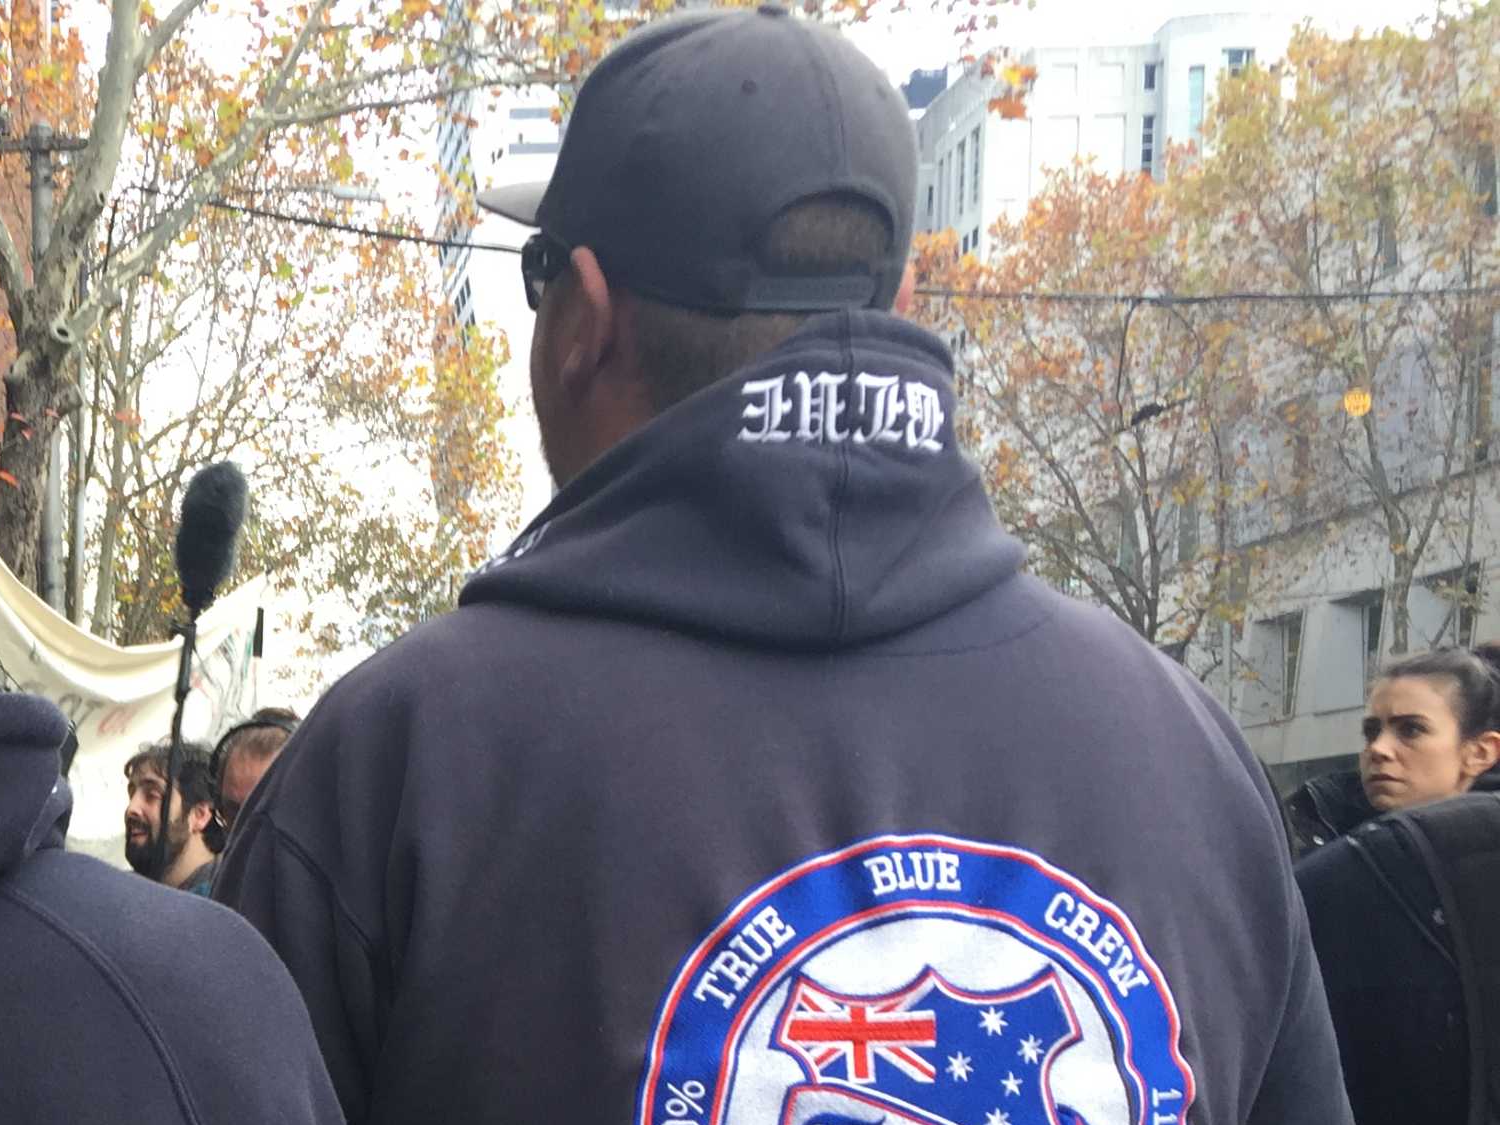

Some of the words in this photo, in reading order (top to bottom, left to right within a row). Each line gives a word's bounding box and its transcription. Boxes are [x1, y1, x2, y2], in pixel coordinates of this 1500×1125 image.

[694, 905, 796, 1009] TRUE
[863, 850, 961, 895] BLUE
[1043, 891, 1150, 998] CREW
